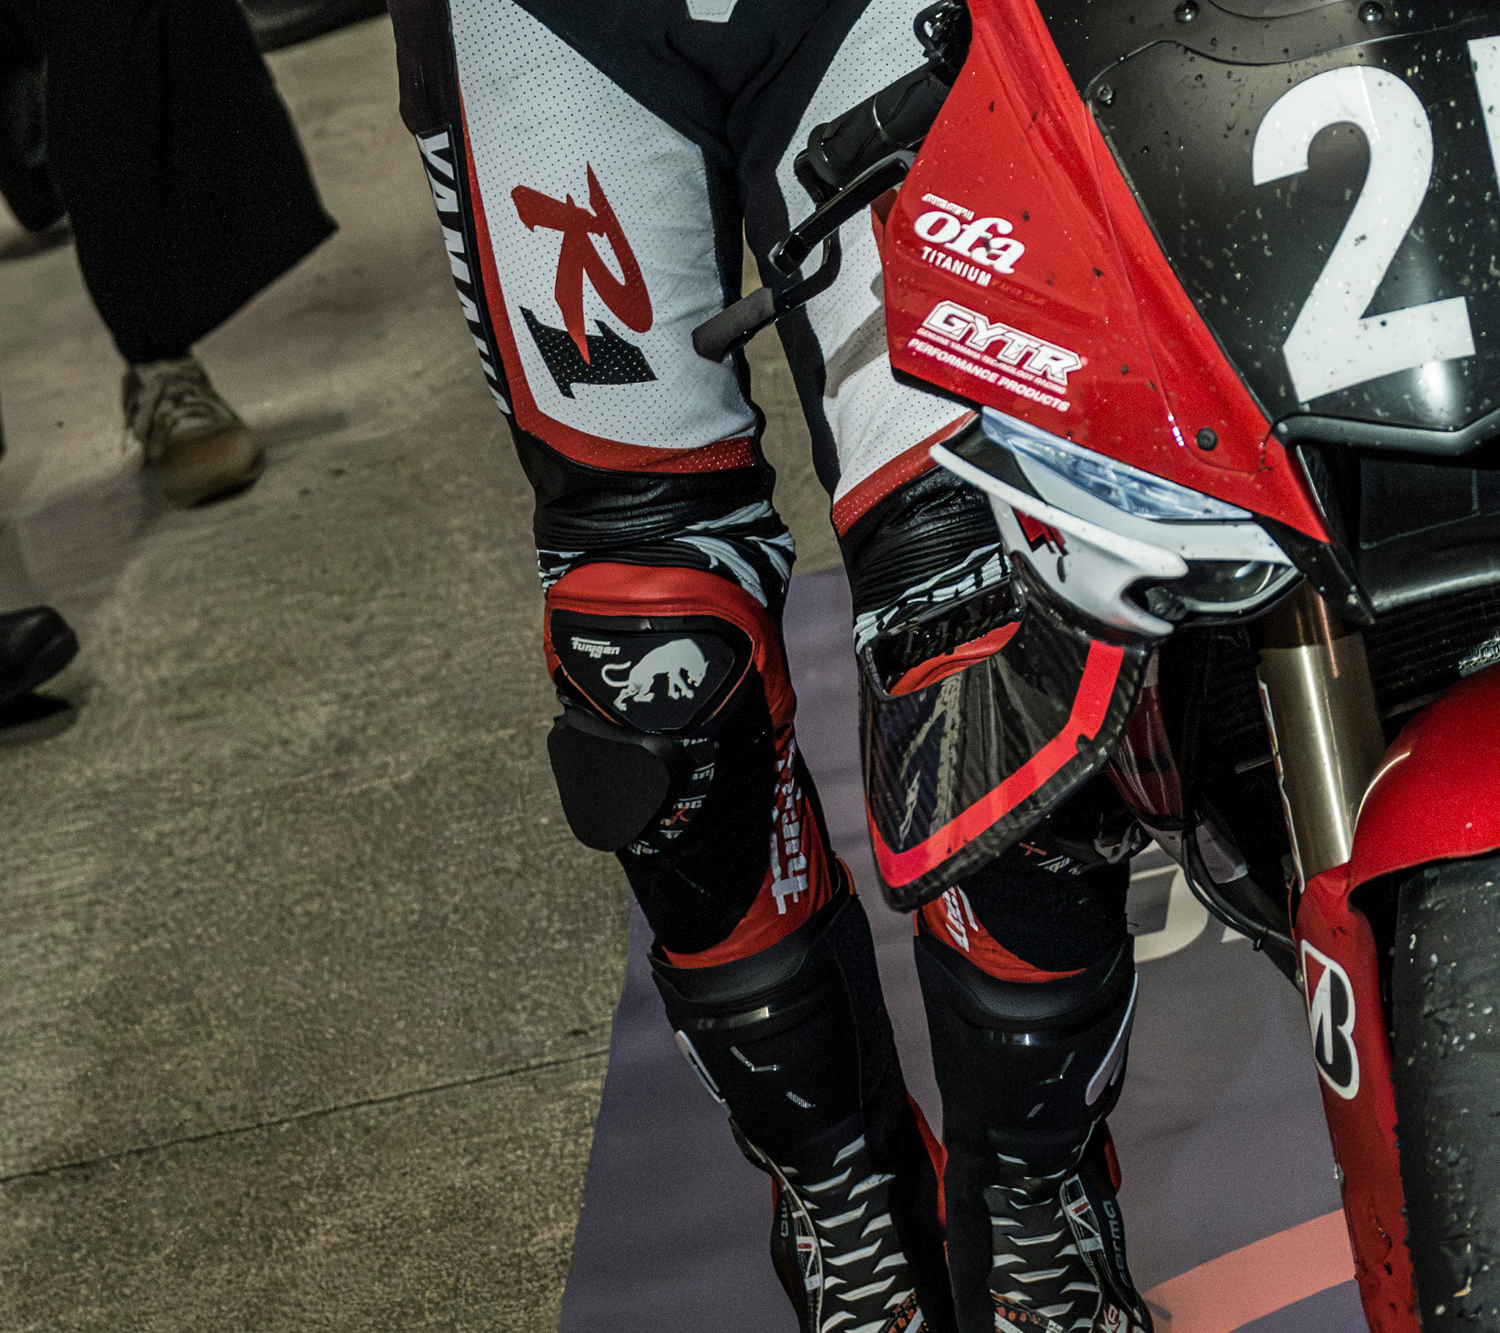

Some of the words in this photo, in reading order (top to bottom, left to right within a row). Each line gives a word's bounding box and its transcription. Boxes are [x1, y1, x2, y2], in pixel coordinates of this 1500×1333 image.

[914, 210, 1025, 274] ofa
[921, 245, 992, 287] TITANIUM
[922, 300, 1083, 385] GYTR
[908, 338, 1004, 385] PERFORMANCE
[997, 376, 1071, 412] PRODUCTS
[571, 636, 620, 658] furygan
